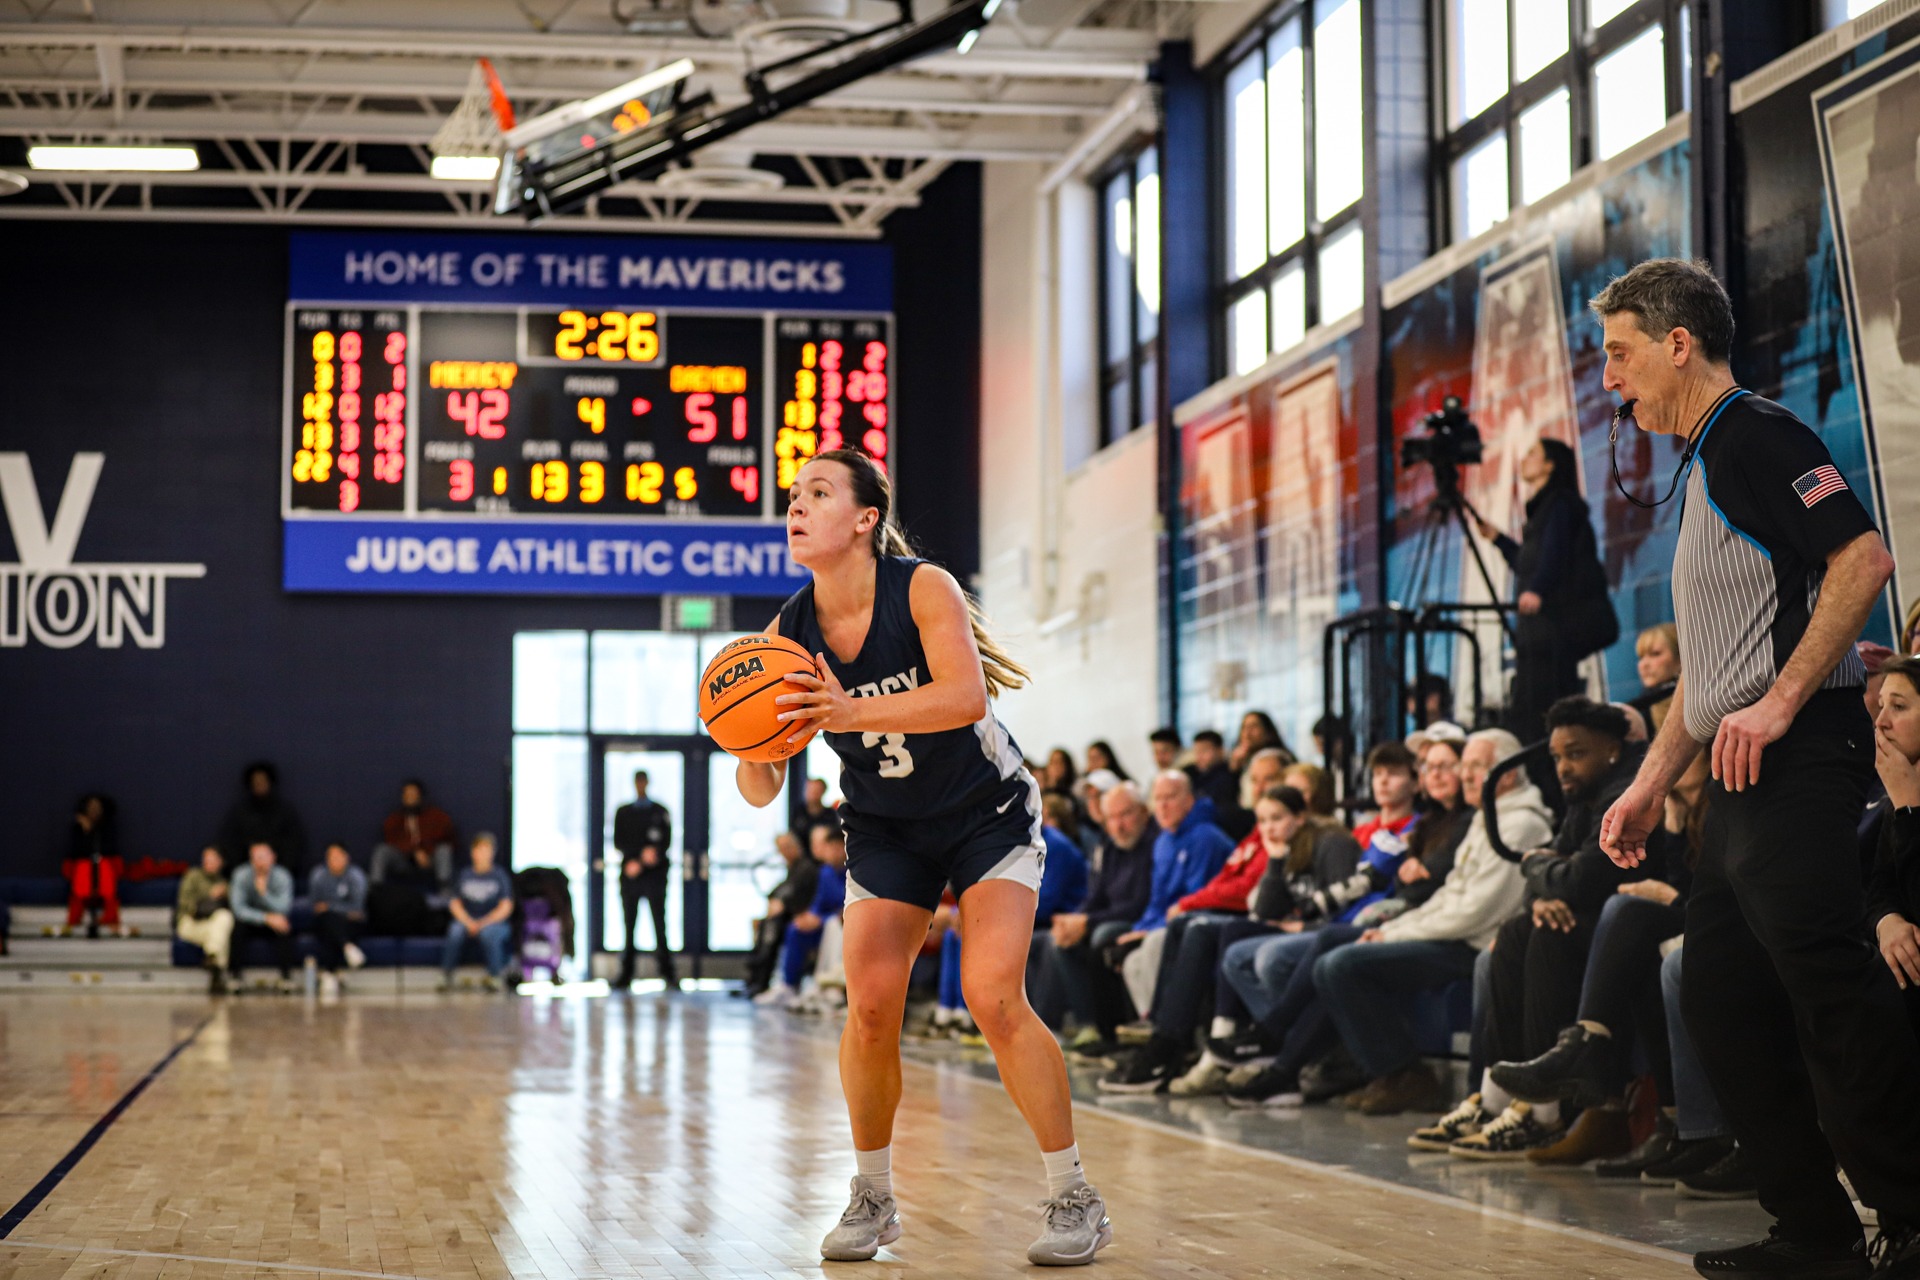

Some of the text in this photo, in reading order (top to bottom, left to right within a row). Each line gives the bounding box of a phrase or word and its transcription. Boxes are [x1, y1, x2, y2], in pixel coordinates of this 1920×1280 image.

[345, 250, 845, 292] HOME OF THE MAVERICKS
[340, 331, 362, 363] 0
[384, 332, 407, 364] 2
[555, 310, 659, 362] 2:26
[820, 340, 843, 371] 2
[863, 341, 887, 372] 2
[447, 389, 510, 439] 42
[578, 397, 606, 434] 4
[685, 392, 747, 442] 51
[449, 459, 508, 502] 3 1
[530, 460, 664, 504] 13 3 12
[731, 466, 758, 502] 4
[346, 537, 813, 576] JUDGE ATHLETIC CENTE
[708, 656, 764, 701] NCAA
[862, 731, 915, 778] 3
